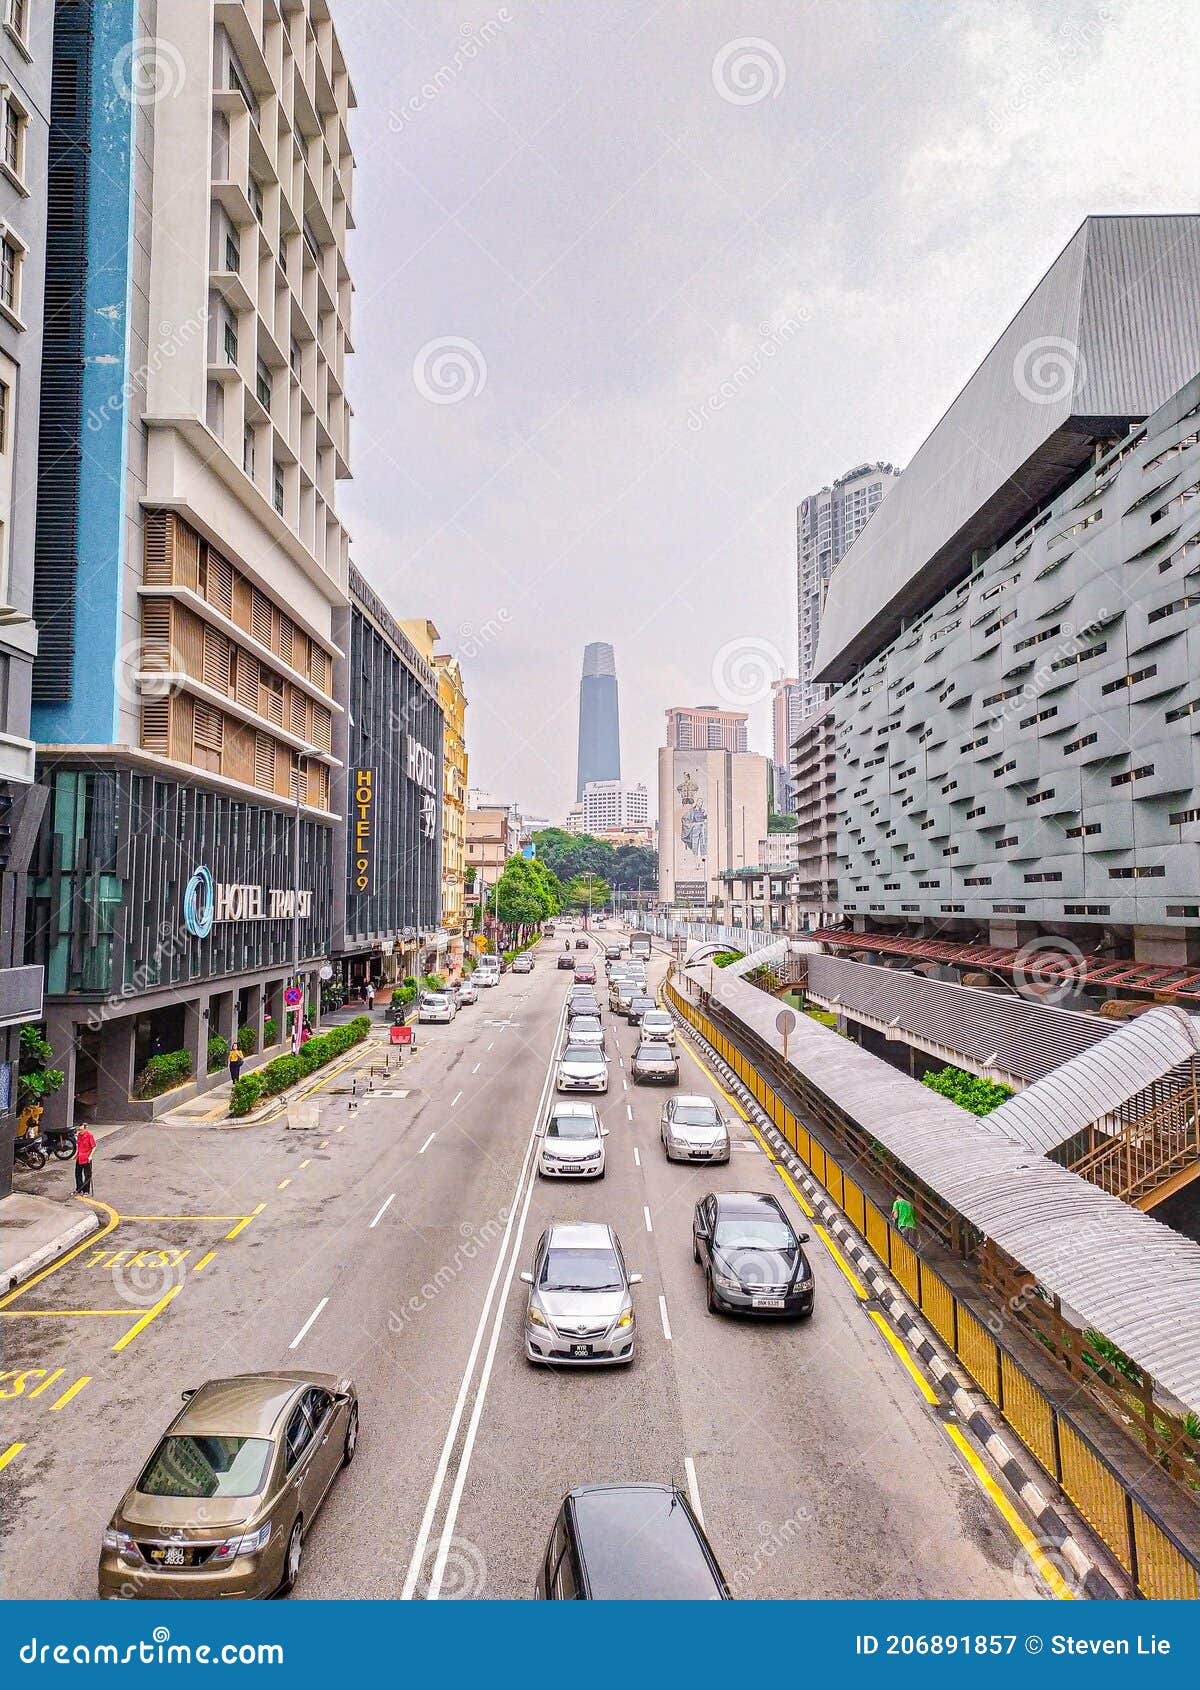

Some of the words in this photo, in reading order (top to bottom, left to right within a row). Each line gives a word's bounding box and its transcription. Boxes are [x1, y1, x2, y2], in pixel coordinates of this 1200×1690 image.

[407, 734, 437, 795] HOTEL
[355, 770, 373, 853] HOTEL
[355, 858, 369, 891] 99
[216, 883, 267, 920] HOTEL
[86, 1249, 192, 1268] TEKSI
